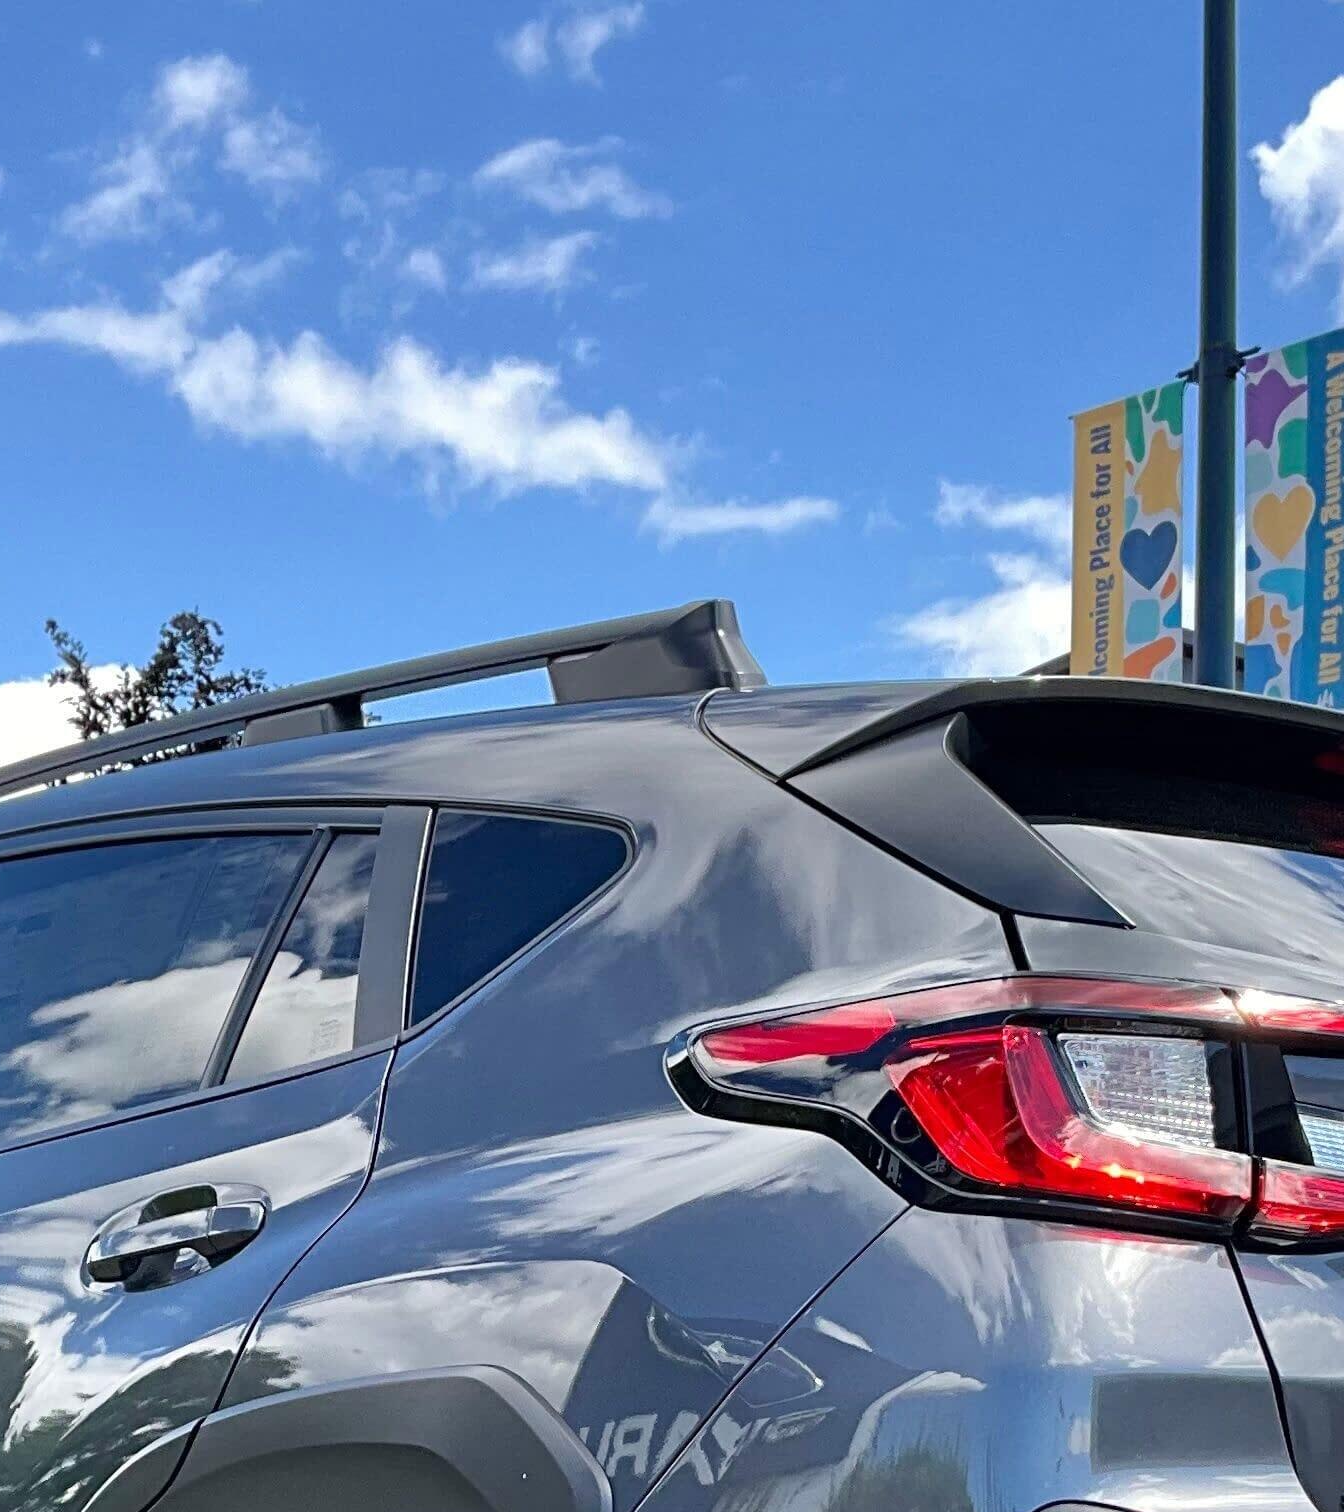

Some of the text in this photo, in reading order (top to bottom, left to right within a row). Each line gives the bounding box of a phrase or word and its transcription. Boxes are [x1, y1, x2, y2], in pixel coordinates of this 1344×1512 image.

[1088, 424, 1115, 677] lcoming Place for All
[1321, 605, 1343, 644] for
[1318, 653, 1341, 684] All
